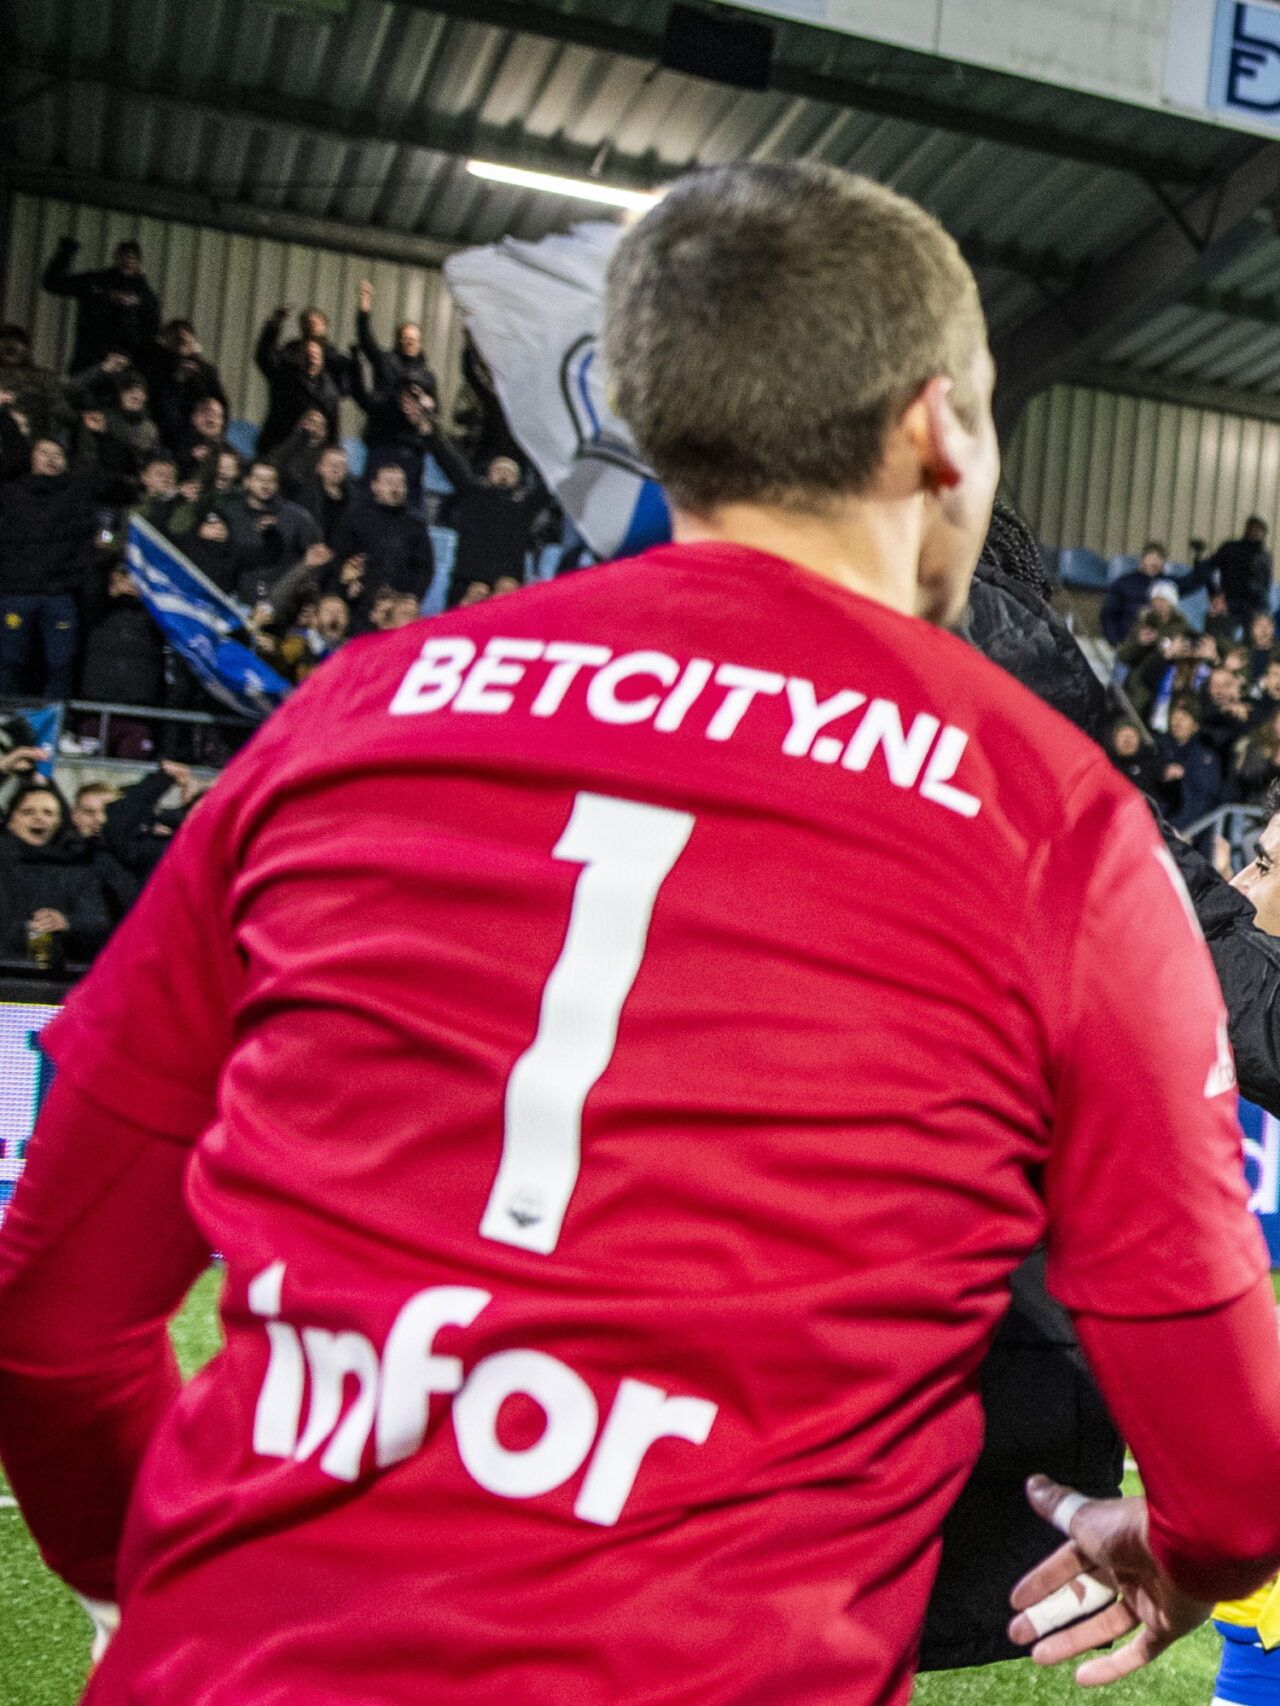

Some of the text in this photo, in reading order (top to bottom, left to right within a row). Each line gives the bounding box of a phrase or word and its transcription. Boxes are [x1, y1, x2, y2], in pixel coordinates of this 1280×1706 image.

[388, 637, 982, 818] BETCITY.NL
[479, 791, 697, 1255] 1
[248, 1260, 718, 1529] infor
